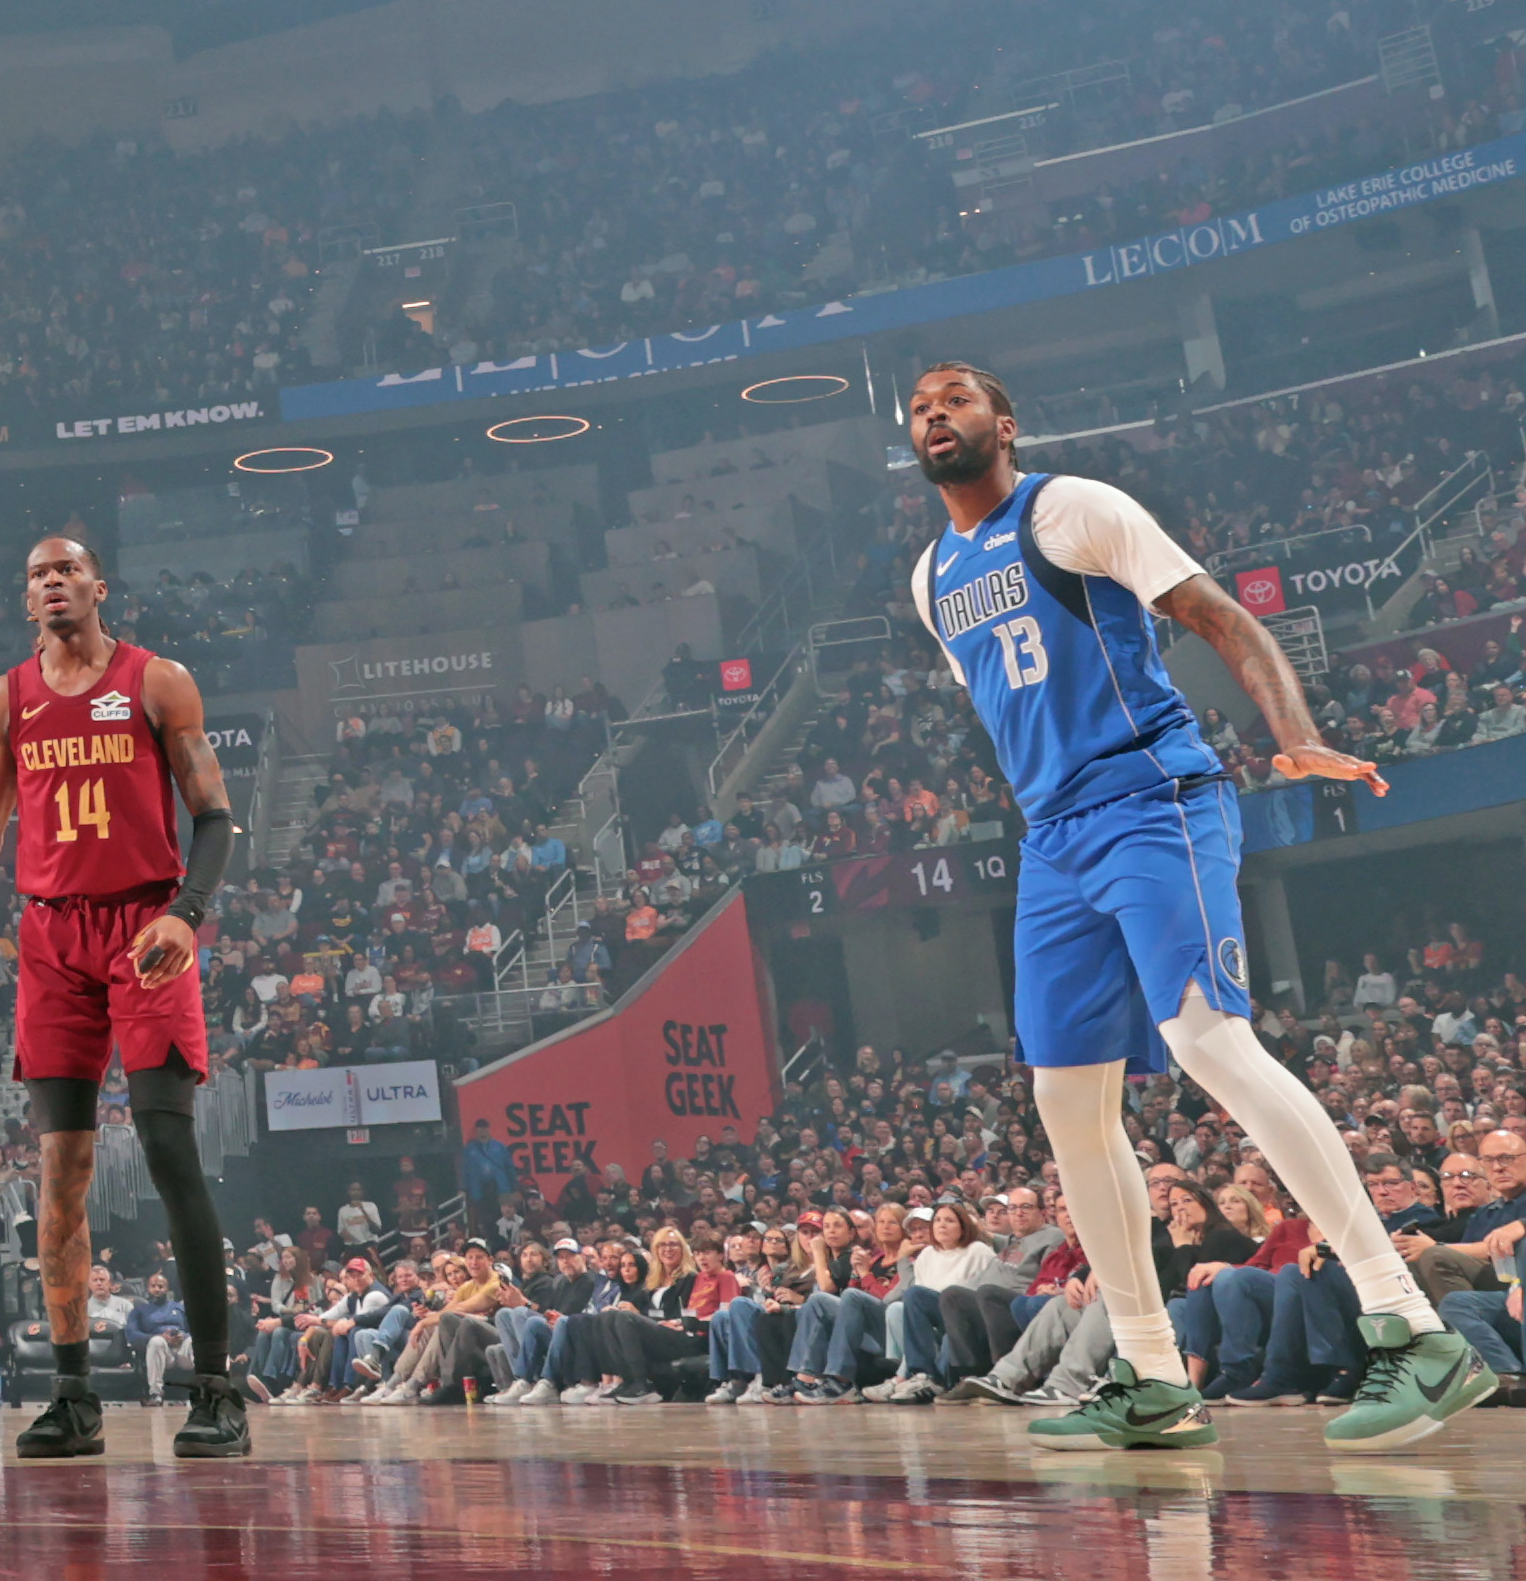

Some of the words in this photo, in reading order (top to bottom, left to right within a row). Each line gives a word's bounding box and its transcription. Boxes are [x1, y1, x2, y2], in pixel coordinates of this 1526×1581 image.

[1289, 216, 1313, 234] OF
[1316, 183, 1429, 226] OSTEOPATHIC
[1432, 159, 1517, 195] MEDICINE
[1316, 183, 1358, 208] LAKE
[1361, 174, 1396, 197] ERIE
[1399, 150, 1475, 184] COLLEGE
[376, 253, 400, 267] 217
[56, 419, 110, 439] LET
[118, 414, 161, 434] EM
[164, 401, 264, 431] KNOW.
[983, 530, 1016, 551] chime
[1289, 558, 1402, 595] TOYOTA
[935, 561, 1029, 642] DALLAS
[363, 651, 493, 680] LITEHOUSE
[992, 615, 1049, 690] 13
[93, 709, 129, 719] CLIFFS
[718, 694, 760, 707] TOYOTA
[21, 733, 134, 771] CLEVELAND
[55, 777, 111, 842] 14
[1323, 784, 1346, 799] FLS
[1333, 807, 1345, 833] 1
[801, 872, 824, 886] FLS
[910, 858, 954, 896] 14
[974, 856, 1006, 880] 1Q
[809, 891, 824, 914] 2
[663, 1020, 728, 1067] SEAT
[367, 1084, 428, 1102] ULTRA
[665, 1072, 741, 1120] GEEK
[505, 1101, 591, 1137] SEAT
[508, 1140, 601, 1175] GEEK
